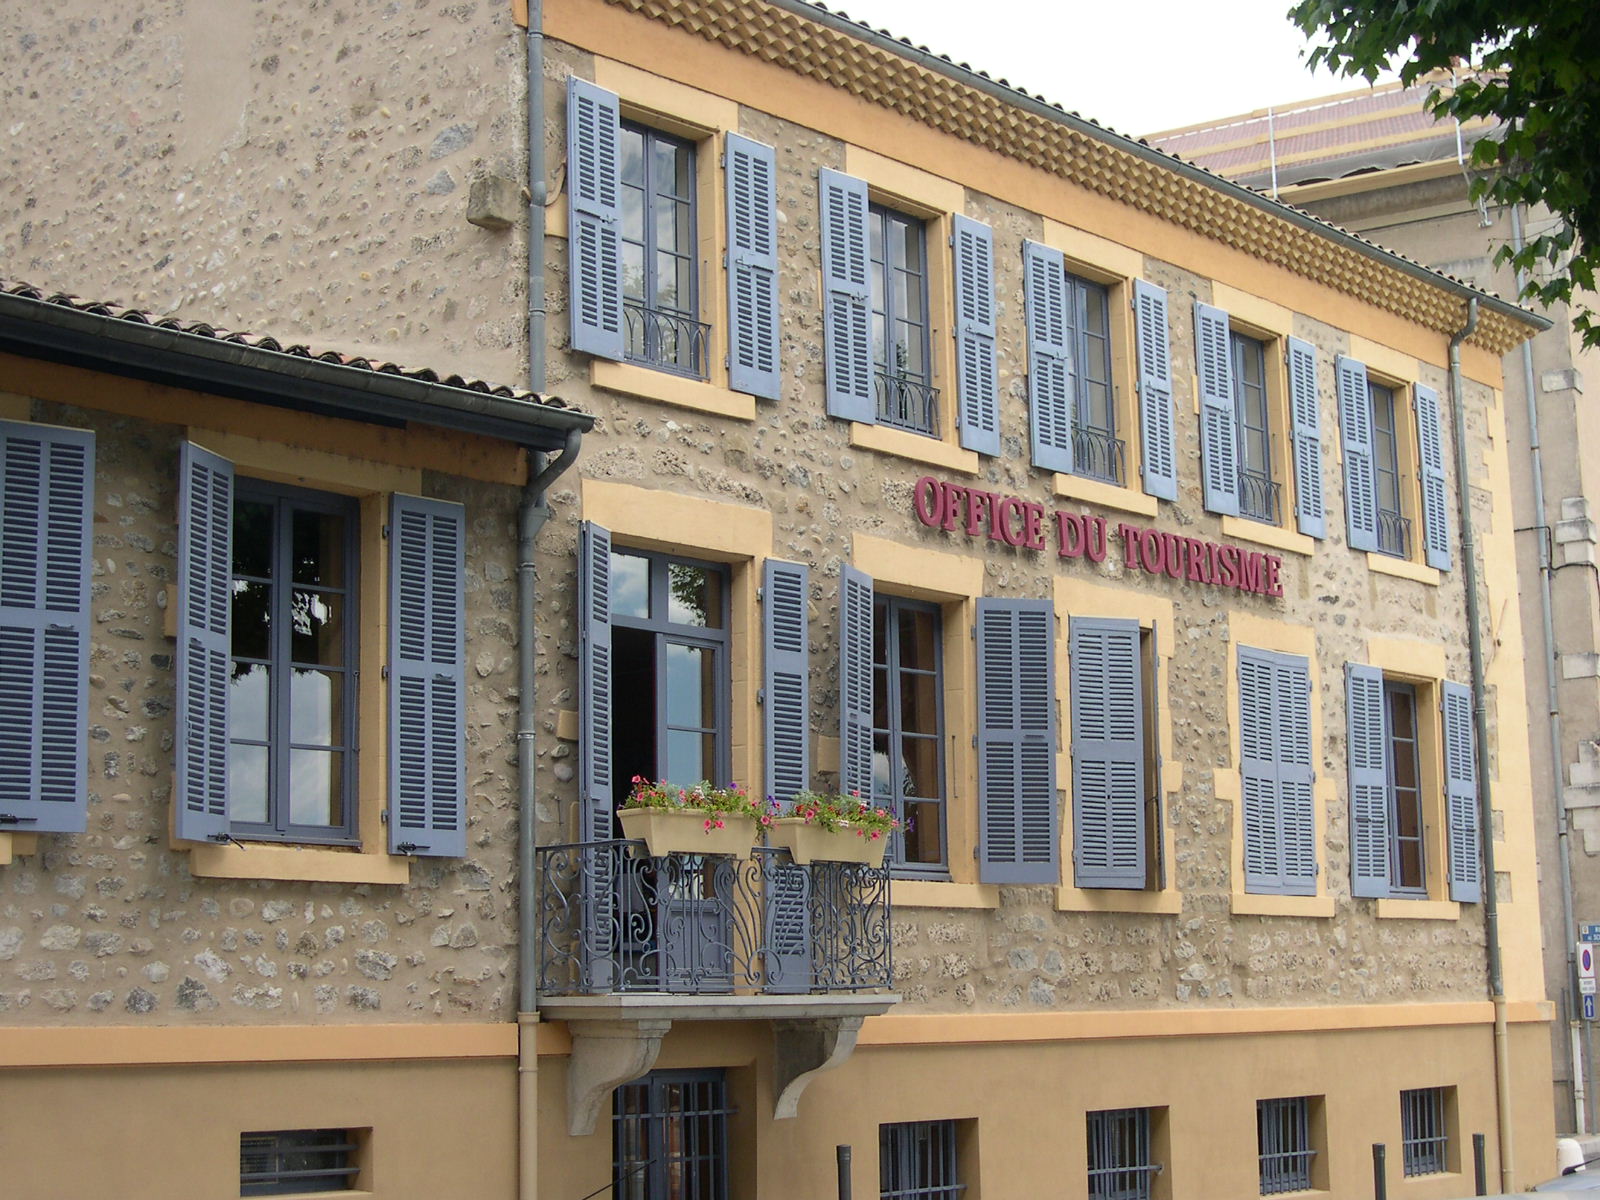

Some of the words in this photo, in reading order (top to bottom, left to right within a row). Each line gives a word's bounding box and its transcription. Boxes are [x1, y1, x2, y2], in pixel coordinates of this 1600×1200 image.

[914, 476, 1046, 551] OFFICE
[1056, 511, 1108, 563] DU
[1119, 523, 1283, 597] TOURISME
